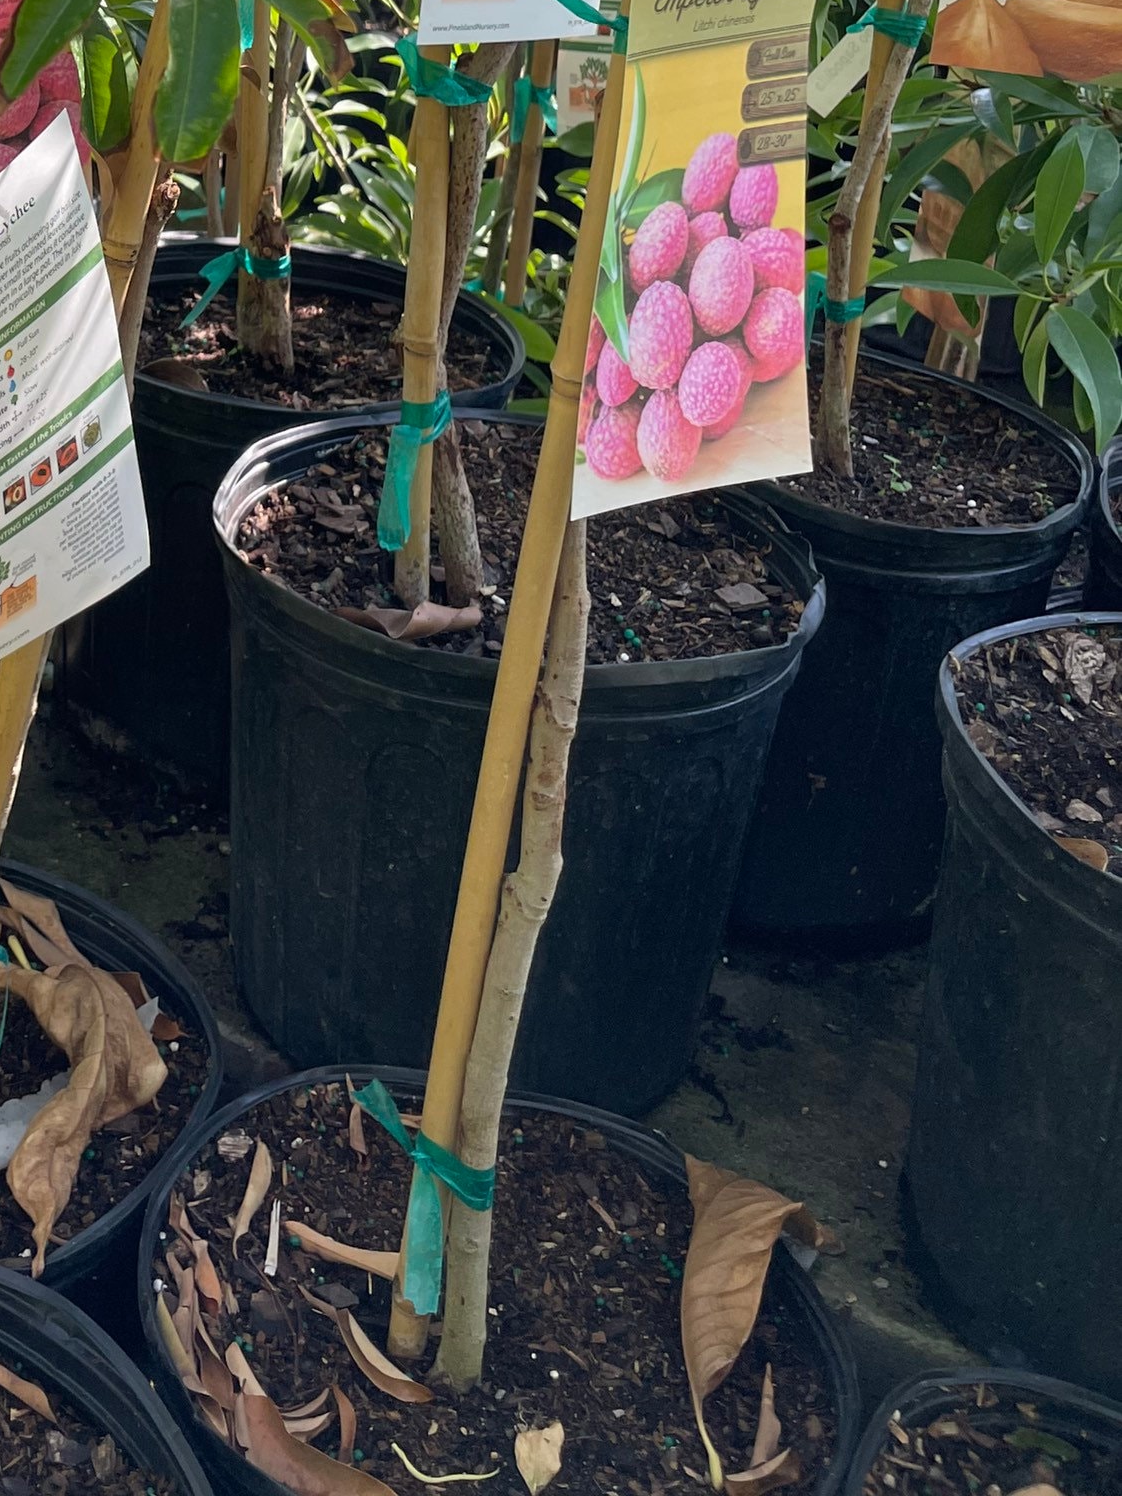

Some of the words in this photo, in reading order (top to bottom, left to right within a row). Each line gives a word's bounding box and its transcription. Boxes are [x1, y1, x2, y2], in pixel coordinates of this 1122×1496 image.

[693, 18, 716, 33] Litchi
[717, 14, 755, 30] chinensis
[0, 300, 45, 342] INFORMATION
[7, 446, 27, 465] Tastes
[36, 429, 49, 443] the
[49, 411, 72, 433] Tropics
[22, 483, 74, 524] INSTRUCTIONS
